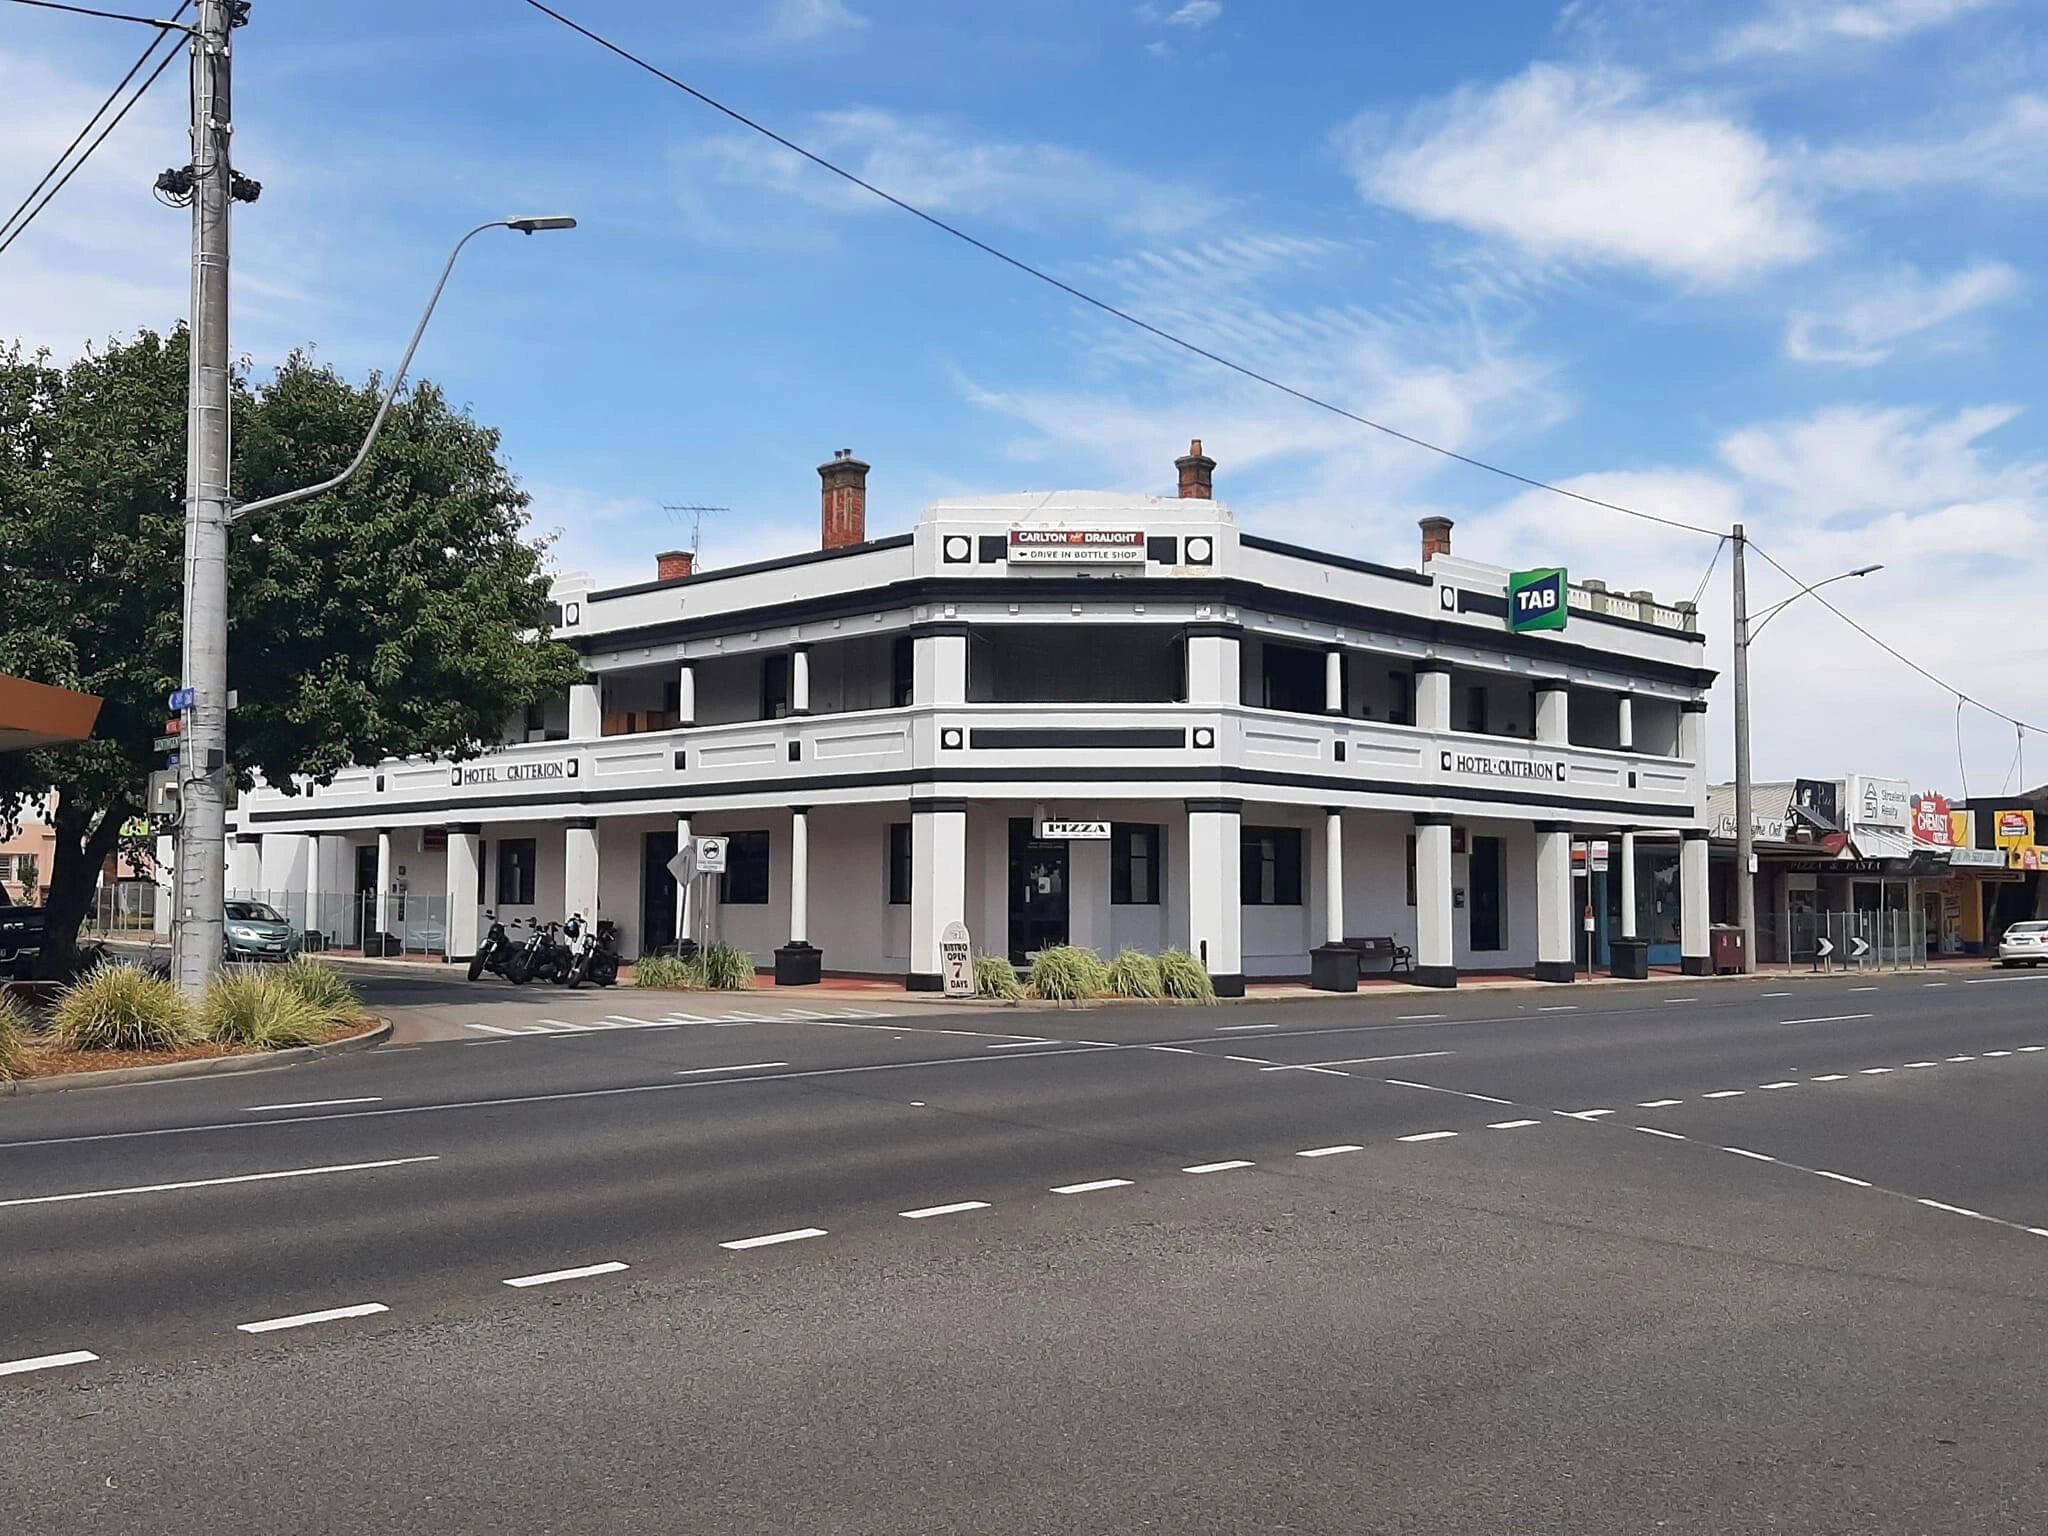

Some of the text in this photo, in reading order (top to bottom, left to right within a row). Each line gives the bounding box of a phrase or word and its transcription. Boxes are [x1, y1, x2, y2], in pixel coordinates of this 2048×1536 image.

[1019, 532, 1137, 543] CARLTON DRAUGHT
[1030, 551, 1137, 559] DRIVE IN BOTTLE SHOP
[1517, 589, 1555, 610] TAB
[464, 762, 562, 783] HOTEL CRITERION
[1457, 755, 1552, 778] HOTEL CRITERION
[1047, 823, 1107, 833] PIZZA
[1917, 812, 1949, 833] CHEMIST
[947, 953, 967, 961] OPEN
[952, 962, 963, 978] 7
[950, 980, 968, 989] DAYS
